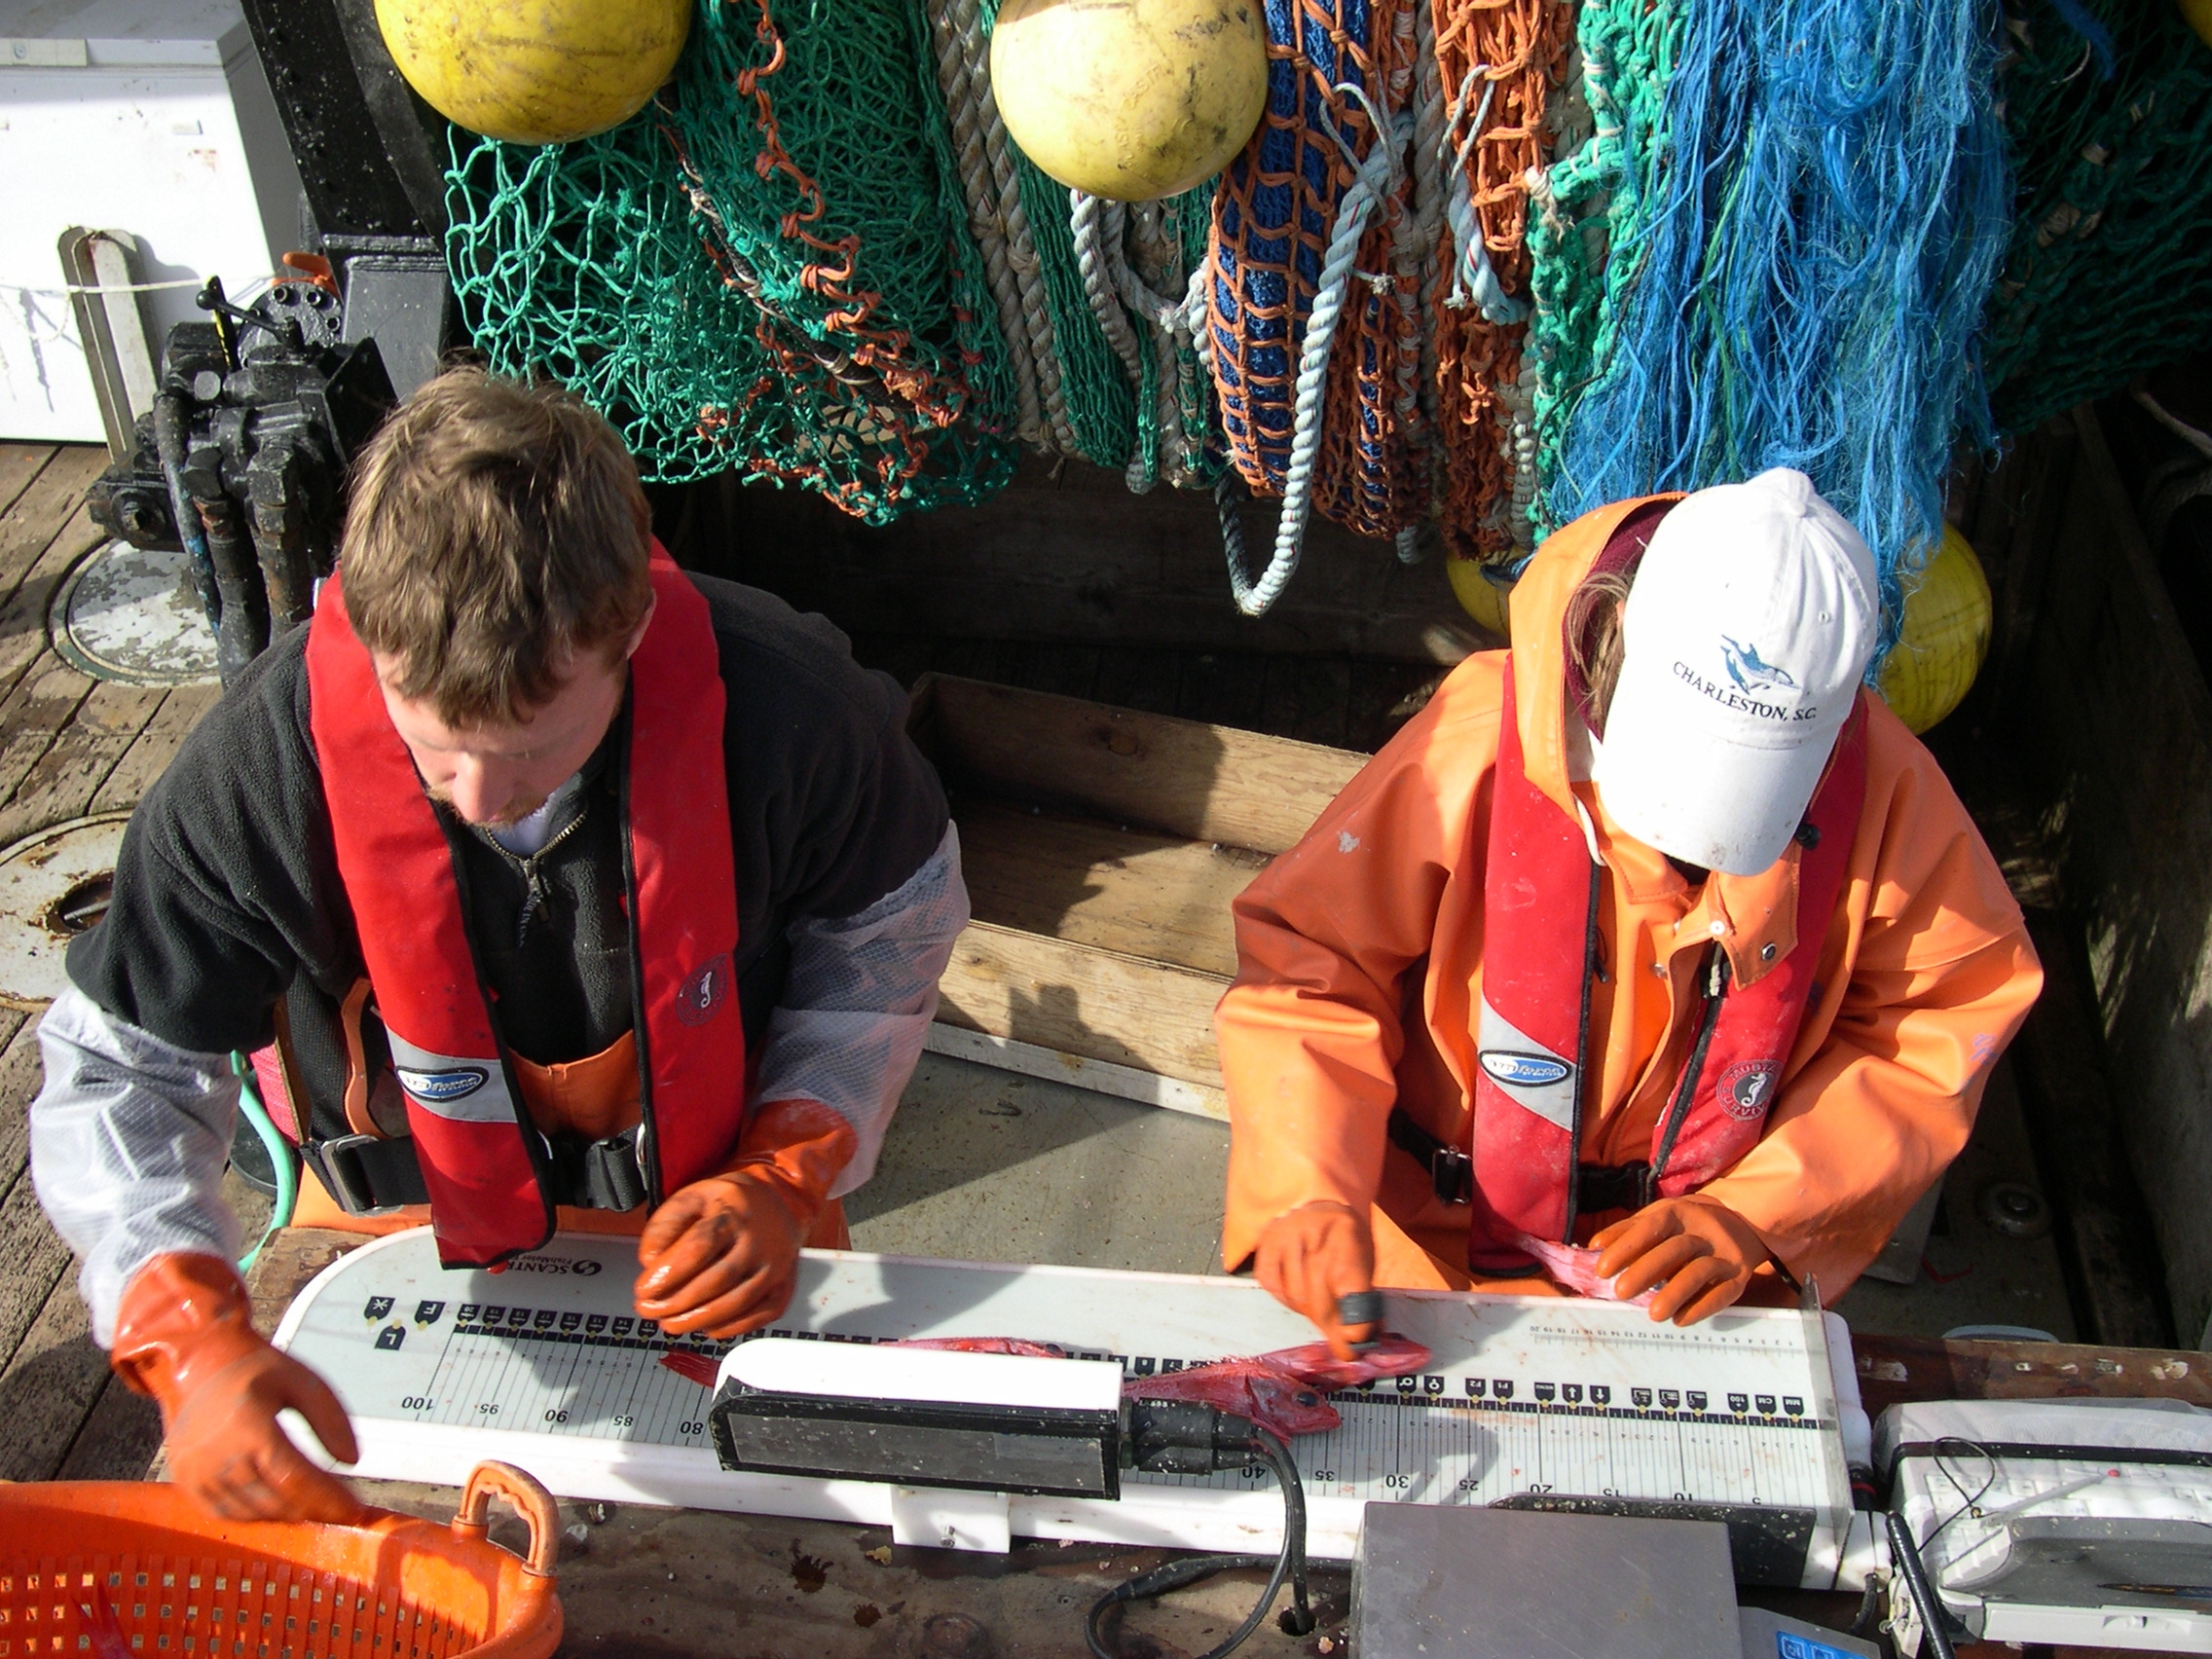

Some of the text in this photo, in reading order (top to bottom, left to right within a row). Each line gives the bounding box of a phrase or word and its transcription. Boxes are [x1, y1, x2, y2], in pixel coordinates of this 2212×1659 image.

[1673, 661, 1818, 721] CHARLESTON, S.C.
[424, 1304, 437, 1314] F
[386, 1334, 397, 1346] L
[1469, 1380, 1482, 1388] F2
[401, 1396, 704, 1435] 100 95 90 85 80
[1242, 1467, 1266, 1479] 40
[1314, 1470, 1335, 1482] 35
[1385, 1474, 1409, 1489] 30
[1458, 1479, 1479, 1491] 25
[1530, 1483, 1553, 1494] 20
